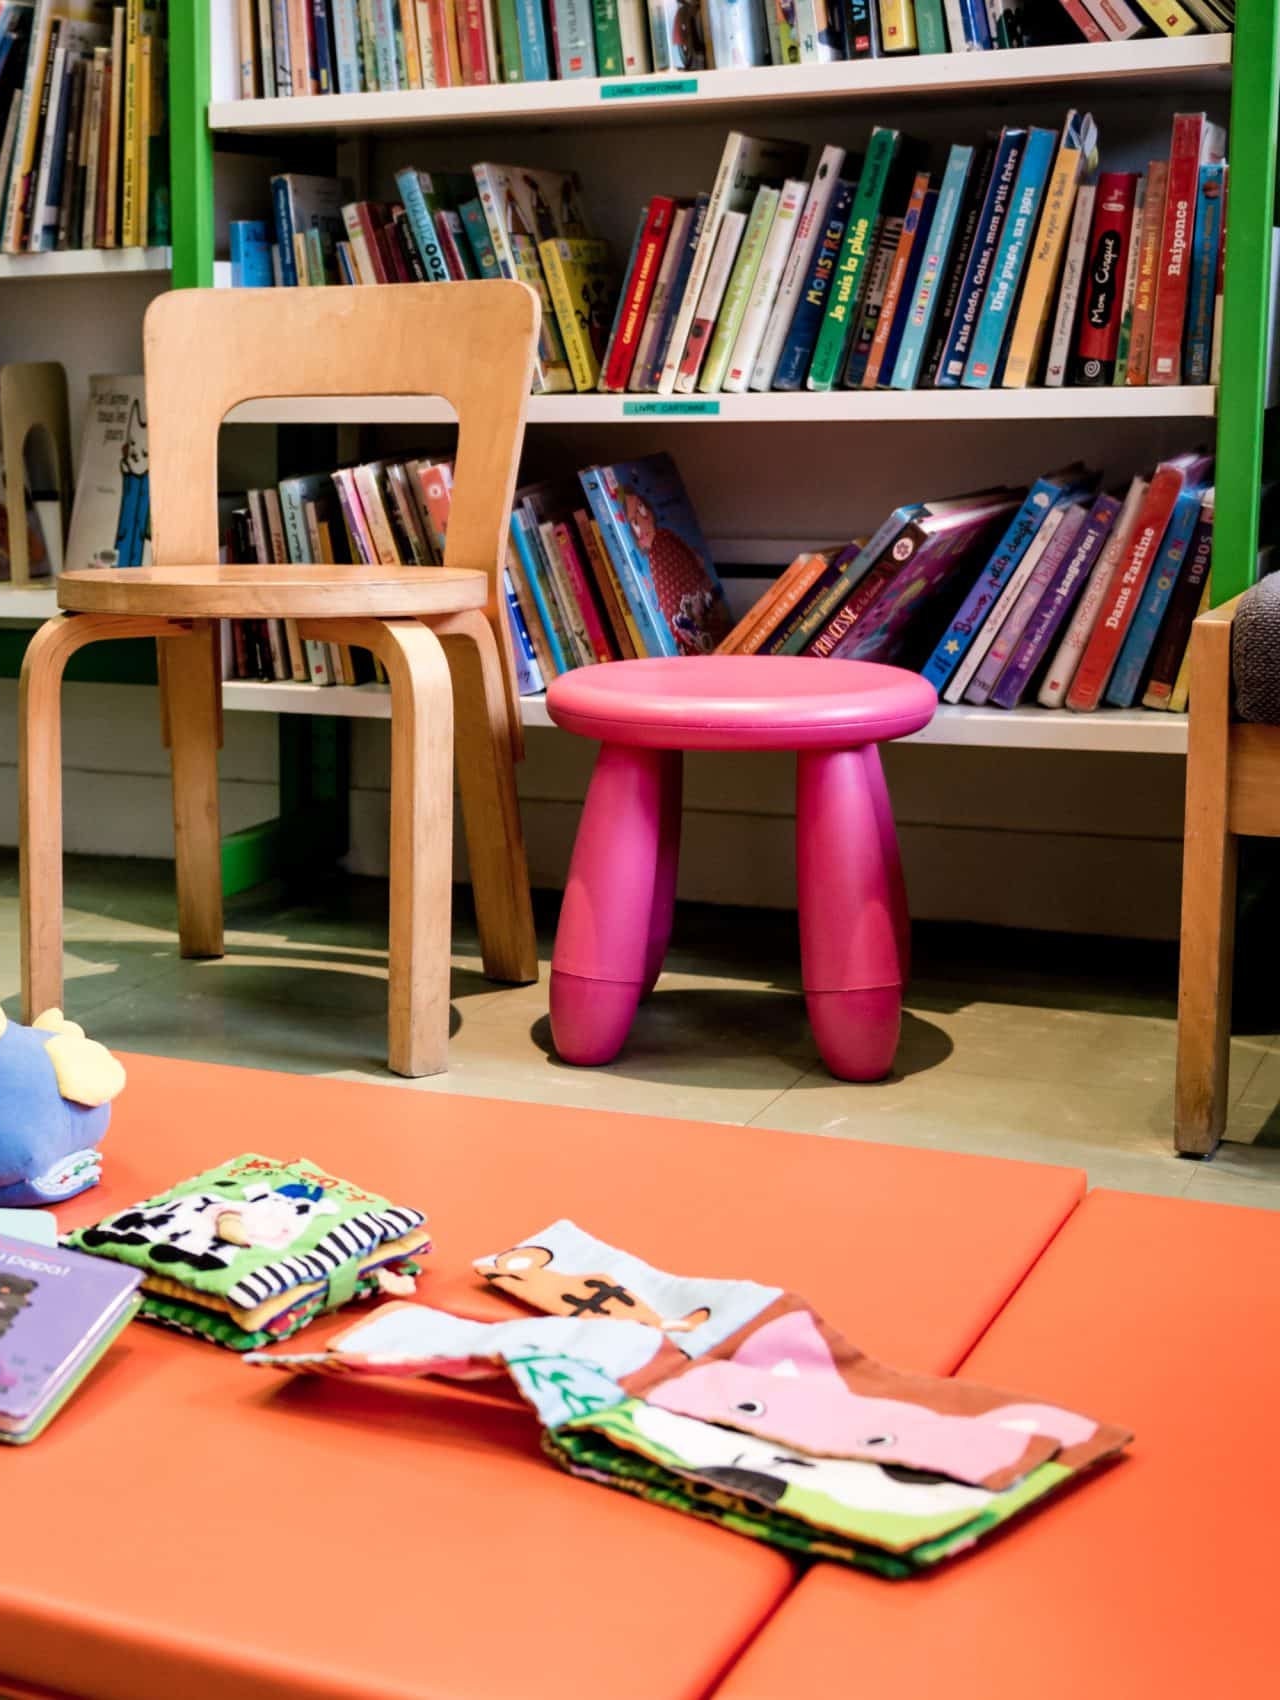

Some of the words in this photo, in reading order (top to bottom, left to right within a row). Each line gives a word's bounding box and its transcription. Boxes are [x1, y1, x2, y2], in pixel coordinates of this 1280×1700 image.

[999, 147, 1020, 183] frère
[991, 181, 1012, 214] p'tit
[1017, 185, 1038, 216] pou
[844, 215, 873, 256] pluie
[984, 213, 1002, 244] mon
[1010, 215, 1027, 238] un
[1166, 199, 1190, 276] Raiponce
[807, 219, 844, 306] MONSTRES
[839, 253, 860, 273] la
[971, 244, 995, 286] Colas,
[997, 237, 1024, 281] puce,
[1094, 237, 1119, 285] Cirque
[832, 271, 855, 303] suis
[961, 284, 983, 323] dodo,
[988, 278, 1009, 313] Une
[827, 301, 847, 323] Je
[1090, 291, 1107, 323] Mon
[953, 321, 972, 353] Fais
[1185, 532, 1213, 585] BOBOS
[1102, 583, 1132, 631] Dame
[1119, 523, 1156, 586] Tartine
[5, 1255, 70, 1278] papa!
